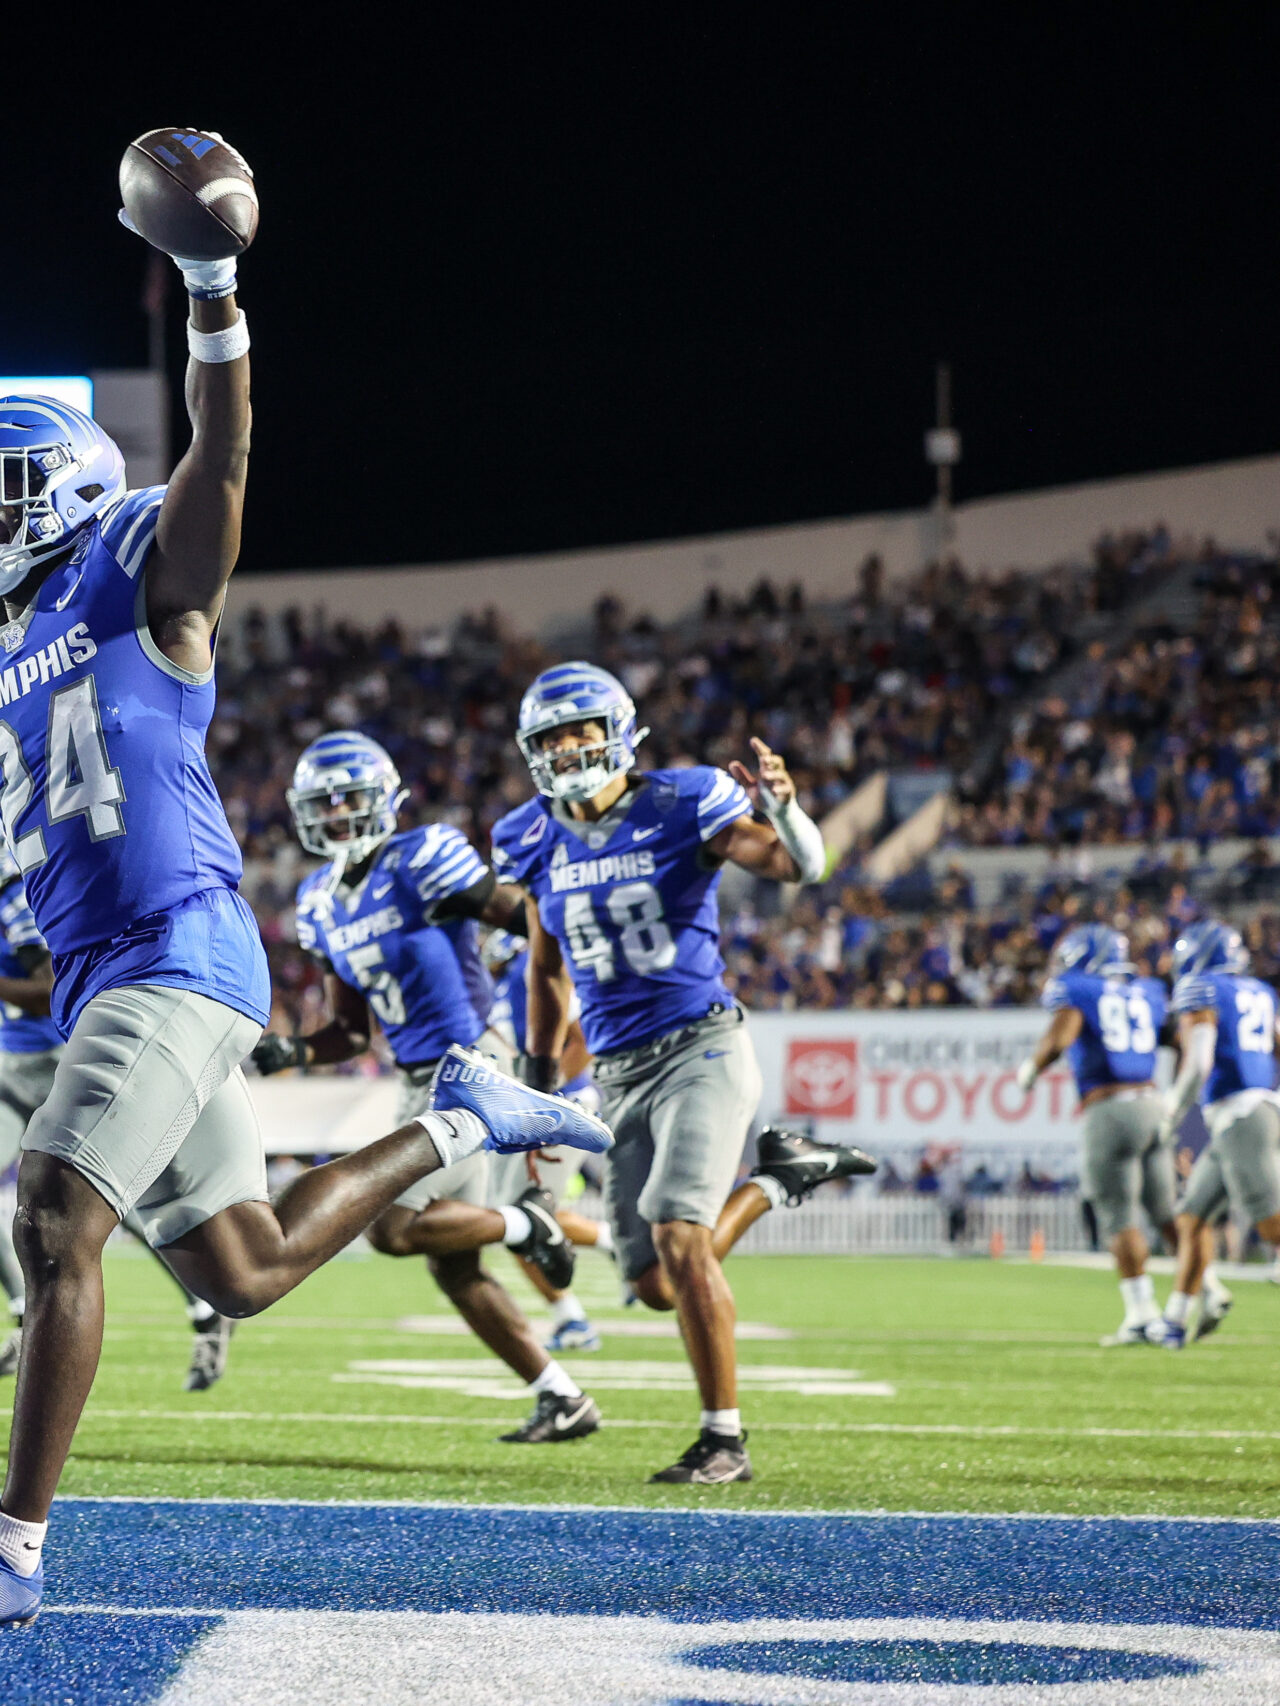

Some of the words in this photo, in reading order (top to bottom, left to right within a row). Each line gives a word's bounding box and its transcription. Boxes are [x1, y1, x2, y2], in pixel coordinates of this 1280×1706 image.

[549, 850, 656, 894] MEMPHIS
[564, 881, 679, 985] 48
[1097, 993, 1157, 1054] 93
